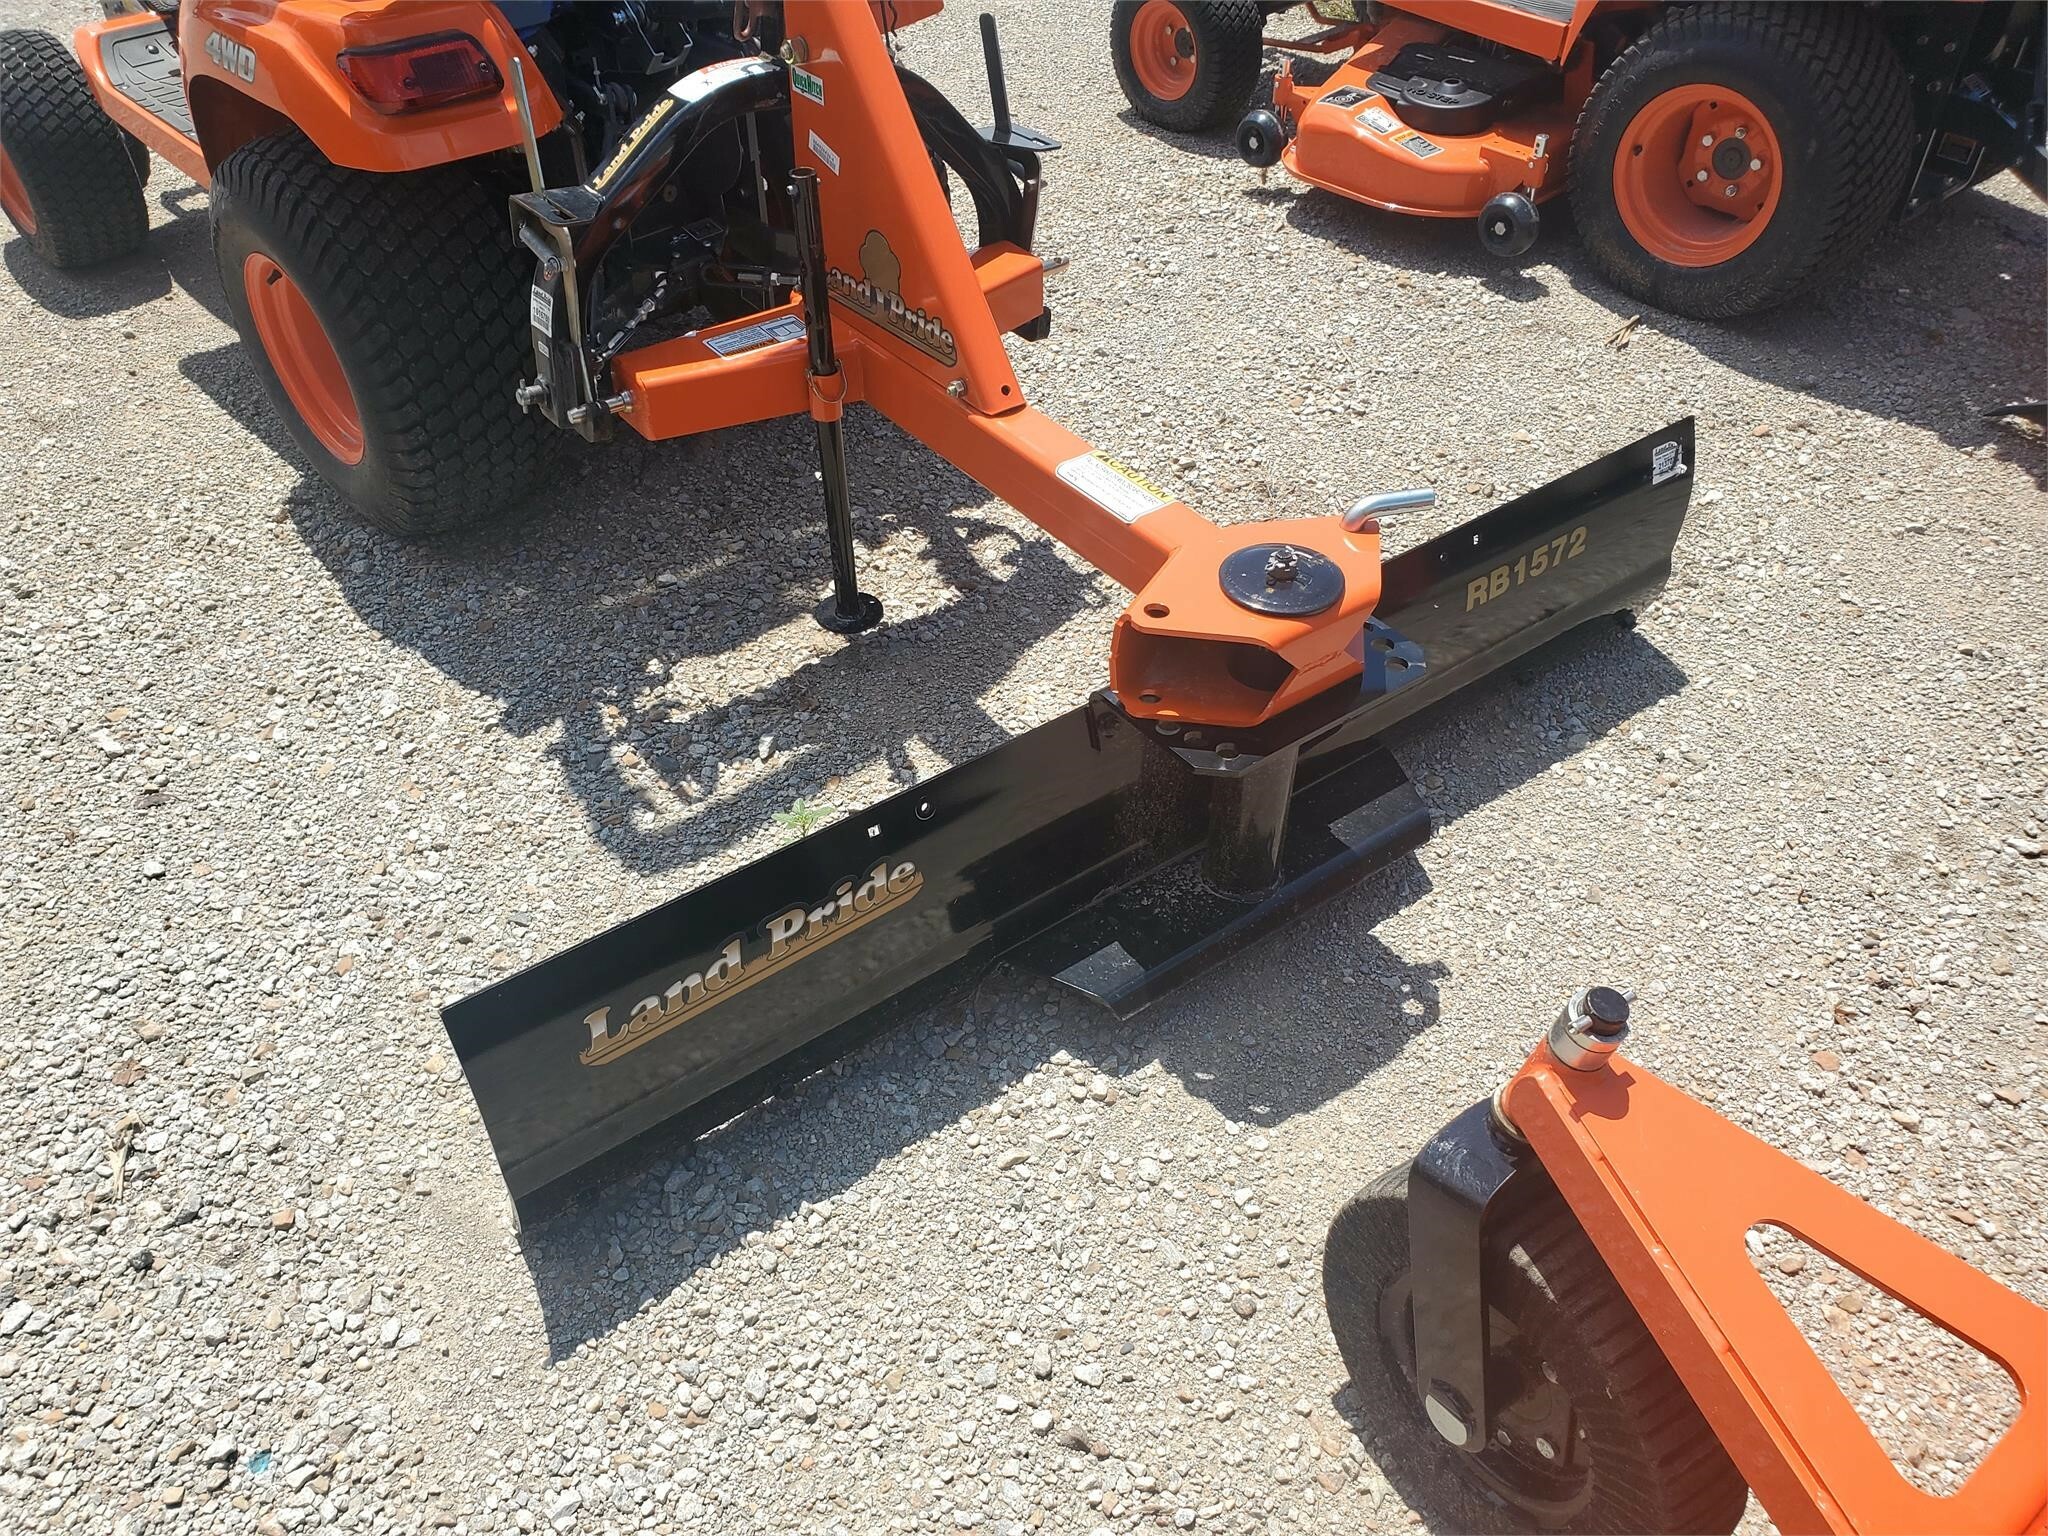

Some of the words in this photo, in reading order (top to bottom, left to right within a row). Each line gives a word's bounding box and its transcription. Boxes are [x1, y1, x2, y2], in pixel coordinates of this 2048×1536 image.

[205, 31, 256, 82] 4WD
[592, 143, 629, 190] Land
[629, 99, 674, 141] Pride
[826, 267, 873, 308] and
[886, 290, 954, 356] Pride
[1109, 460, 1169, 499] CAUTION
[1466, 526, 1588, 612] RB1572
[584, 938, 746, 1057] Land
[766, 860, 917, 961] Pride
